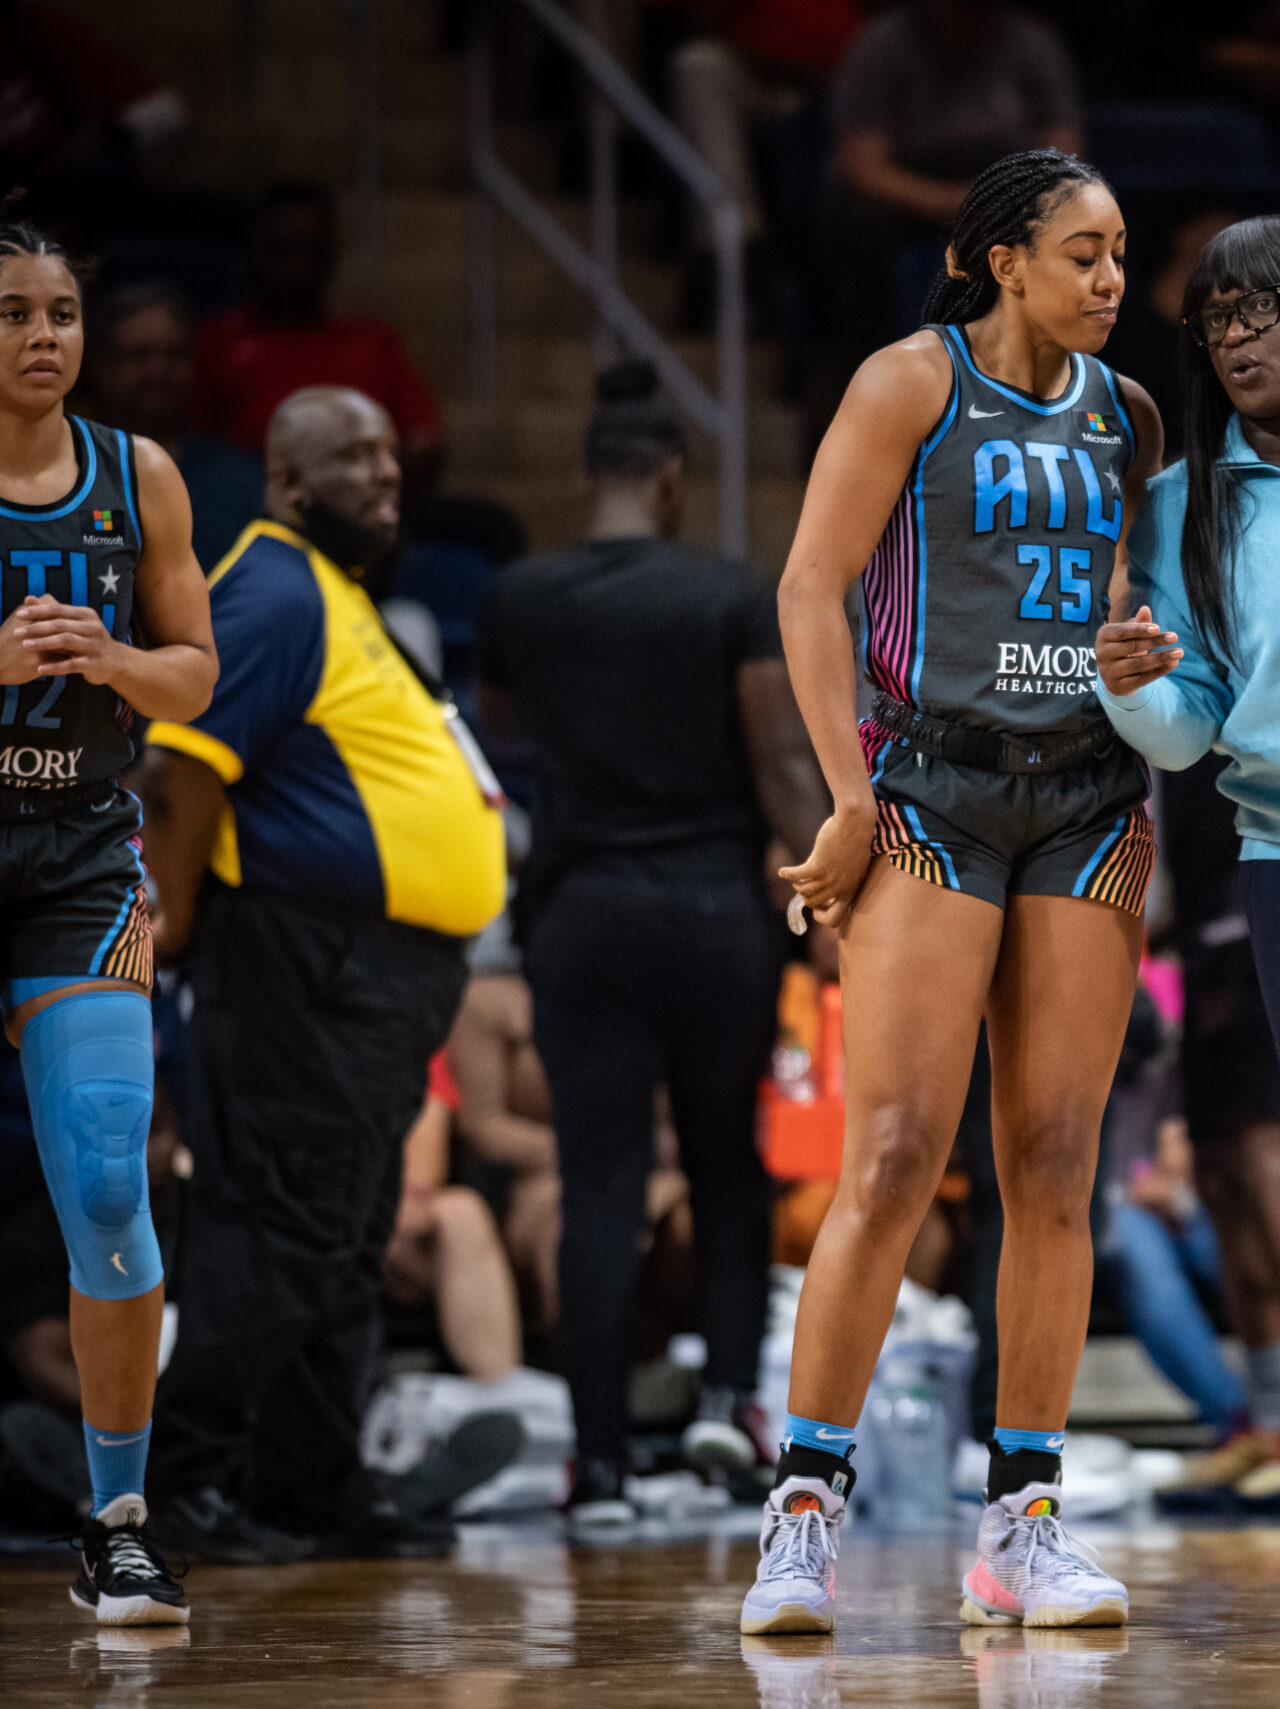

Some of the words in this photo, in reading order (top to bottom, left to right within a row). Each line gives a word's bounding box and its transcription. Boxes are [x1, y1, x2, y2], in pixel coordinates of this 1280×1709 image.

[1081, 432, 1122, 445] Microsoft
[974, 440, 1122, 543] ATL
[82, 534, 124, 546] Microsoft
[0, 550, 115, 636] TL
[1017, 544, 1092, 623] 25
[996, 642, 1098, 678] EMOR
[994, 678, 1097, 695] HEALTHCAR
